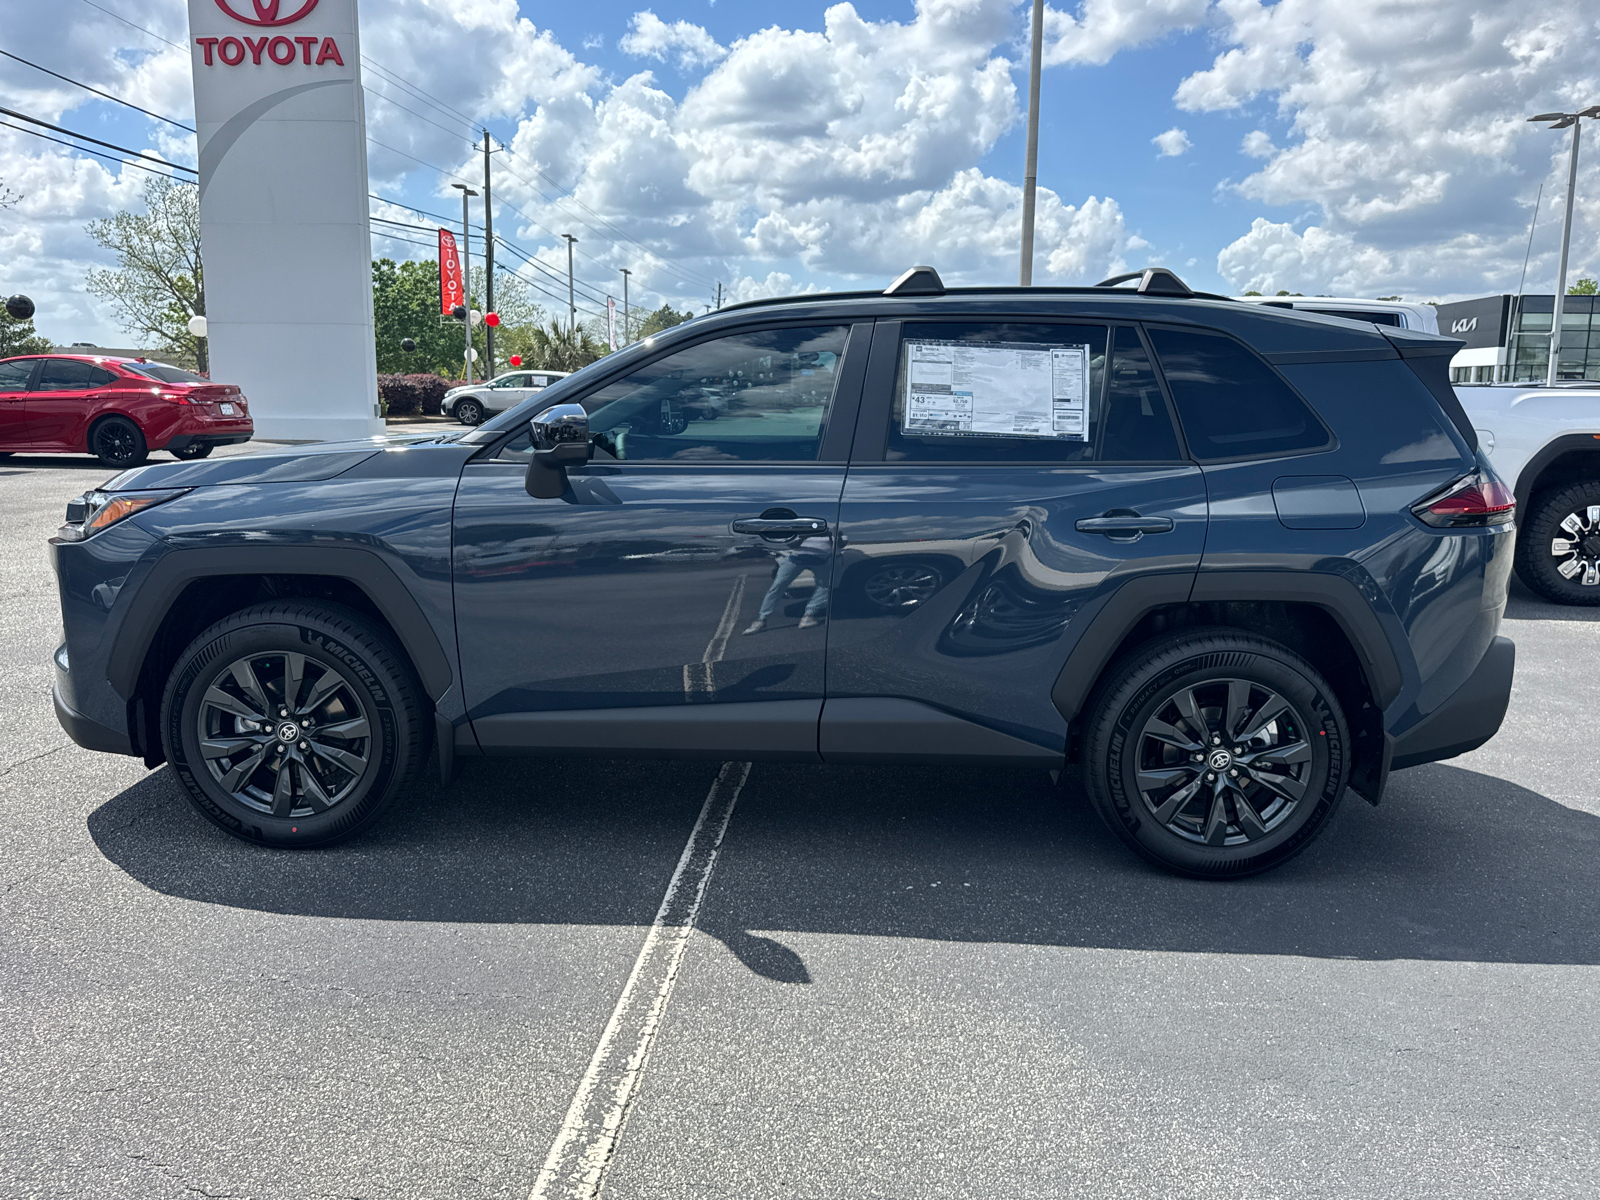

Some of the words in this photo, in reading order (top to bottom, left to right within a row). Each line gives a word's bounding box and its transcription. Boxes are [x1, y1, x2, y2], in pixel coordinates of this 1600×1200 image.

[196, 36, 344, 66] TOYOTA
[446, 249, 457, 312] TOYOTA
[1451, 317, 1478, 333] KIA
[914, 396, 925, 404] 43
[325, 641, 386, 702] MICHELIN
[1109, 732, 1129, 808] MICHELIN
[1324, 720, 1341, 796] MICHELIN
[180, 771, 239, 828] MICHELIN
